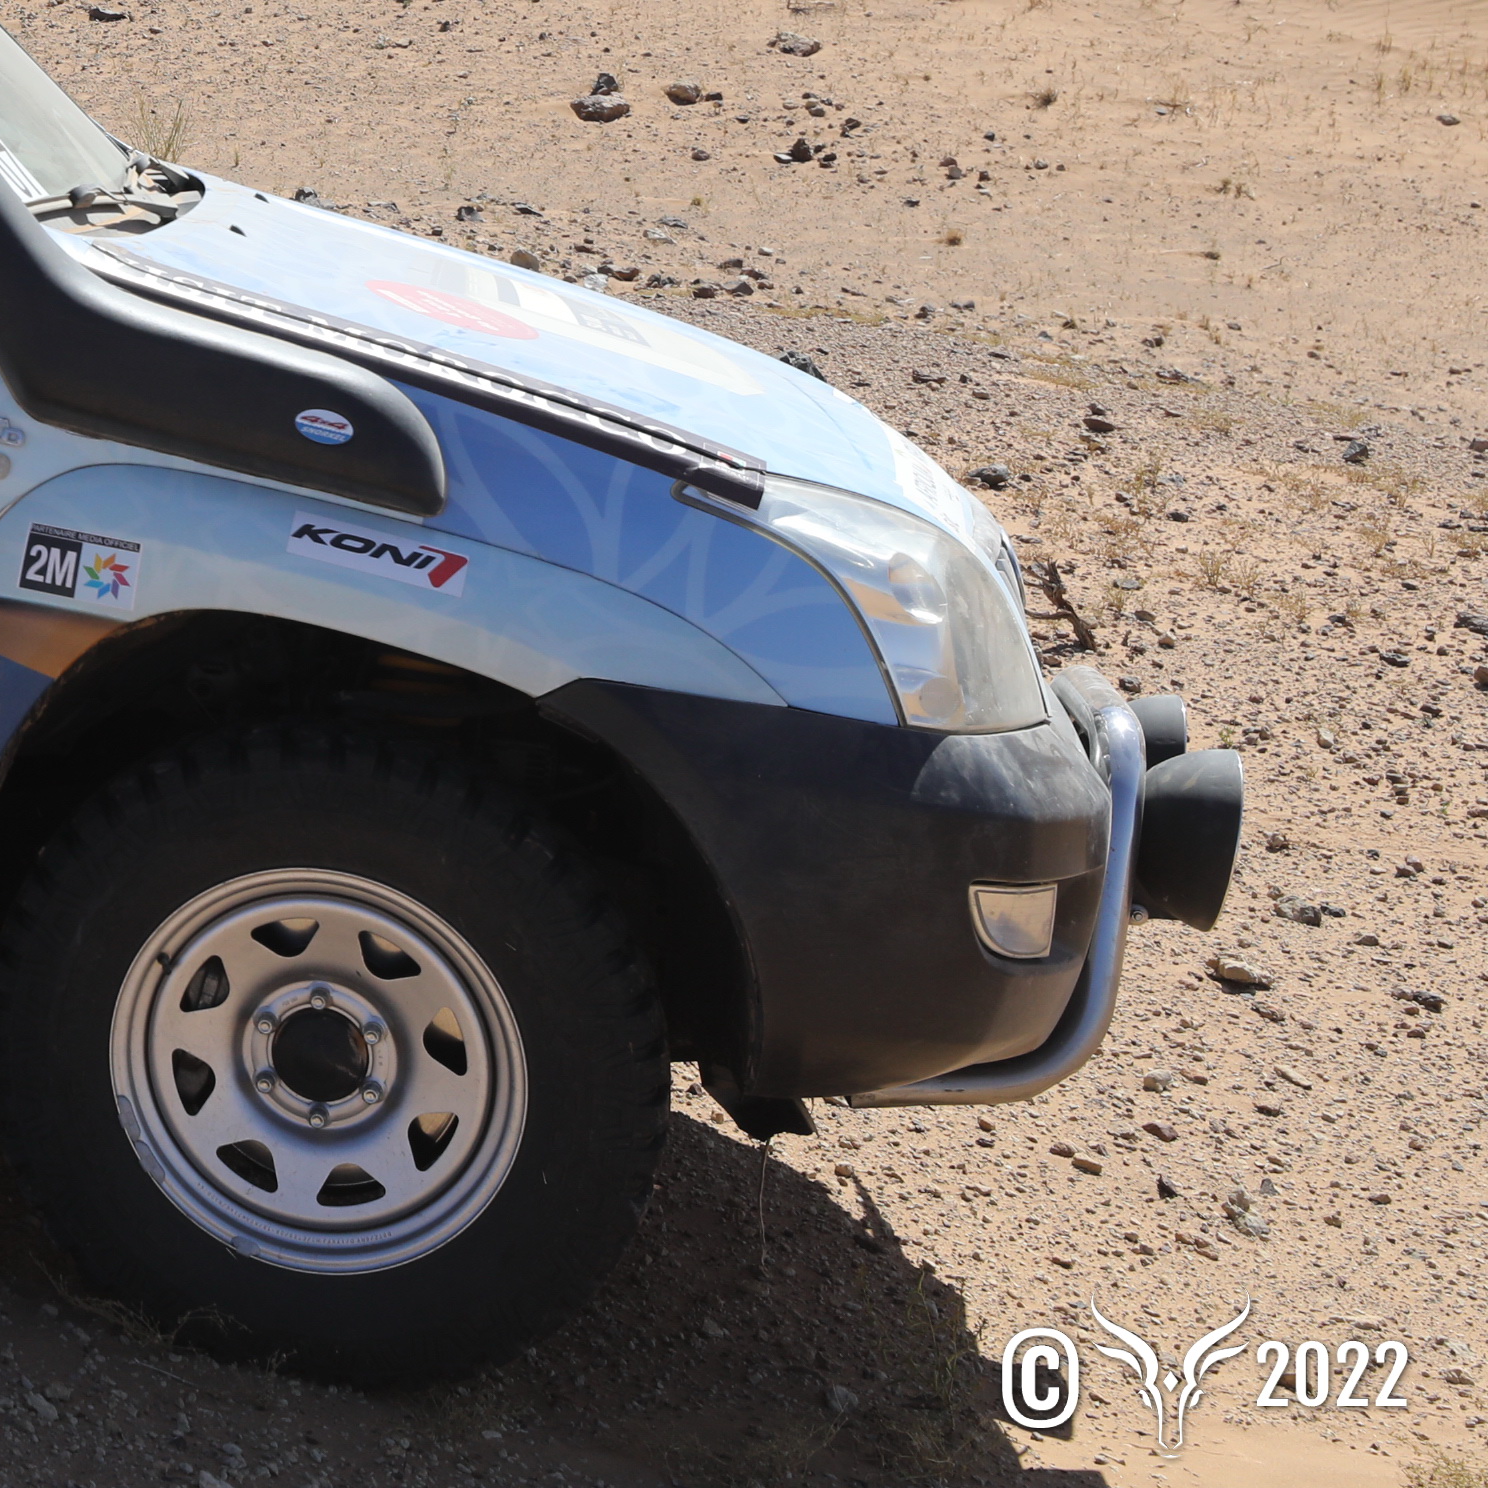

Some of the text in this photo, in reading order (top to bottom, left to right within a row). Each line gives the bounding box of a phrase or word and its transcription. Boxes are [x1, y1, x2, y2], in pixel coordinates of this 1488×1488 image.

[298, 313, 688, 457] MOROCCO
[32, 523, 139, 552] PARTENAIRE MEDIA OFFICIEL
[291, 524, 437, 570] KONI
[25, 544, 78, 588] 2M
